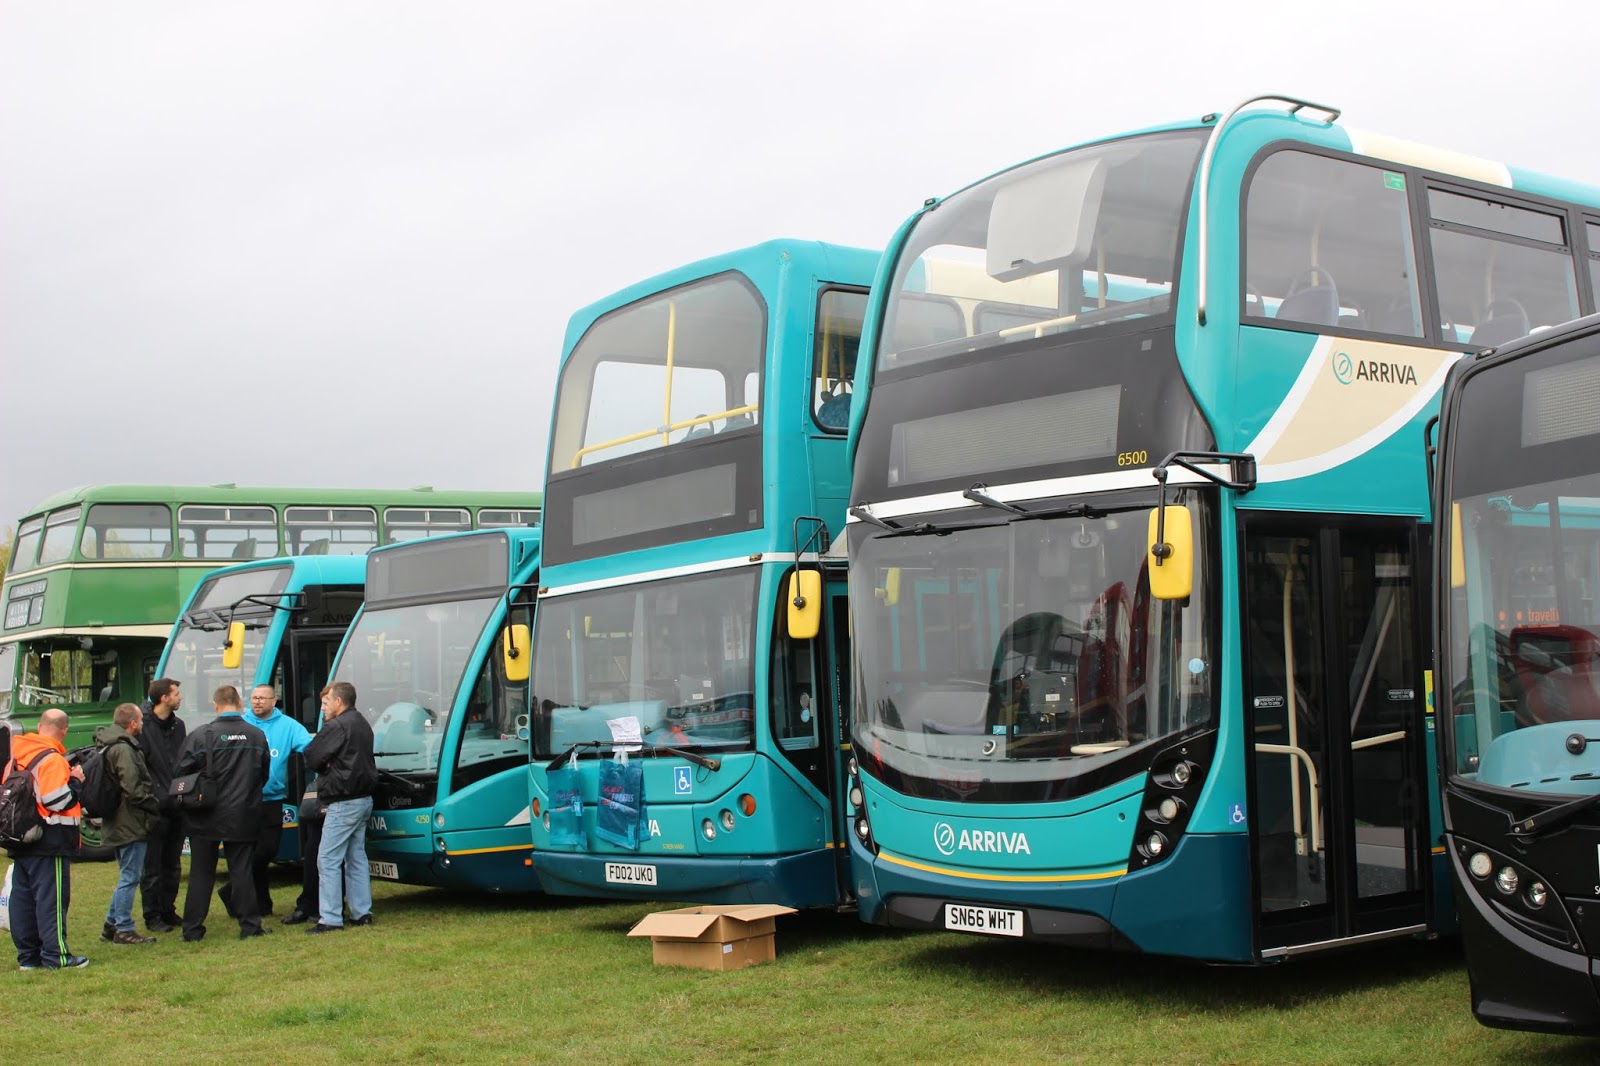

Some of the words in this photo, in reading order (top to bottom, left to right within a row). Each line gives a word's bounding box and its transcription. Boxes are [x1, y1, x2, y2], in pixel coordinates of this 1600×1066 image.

[1356, 360, 1418, 385] ARRIVA
[1117, 450, 1147, 466] 6500
[416, 814, 430, 824] 4250
[958, 829, 1031, 855] ARRIVA
[381, 863, 394, 876] AUT
[609, 865, 633, 880] FD02
[634, 867, 653, 882] UKO
[950, 907, 984, 928] SN66
[988, 910, 1016, 931] WHT
